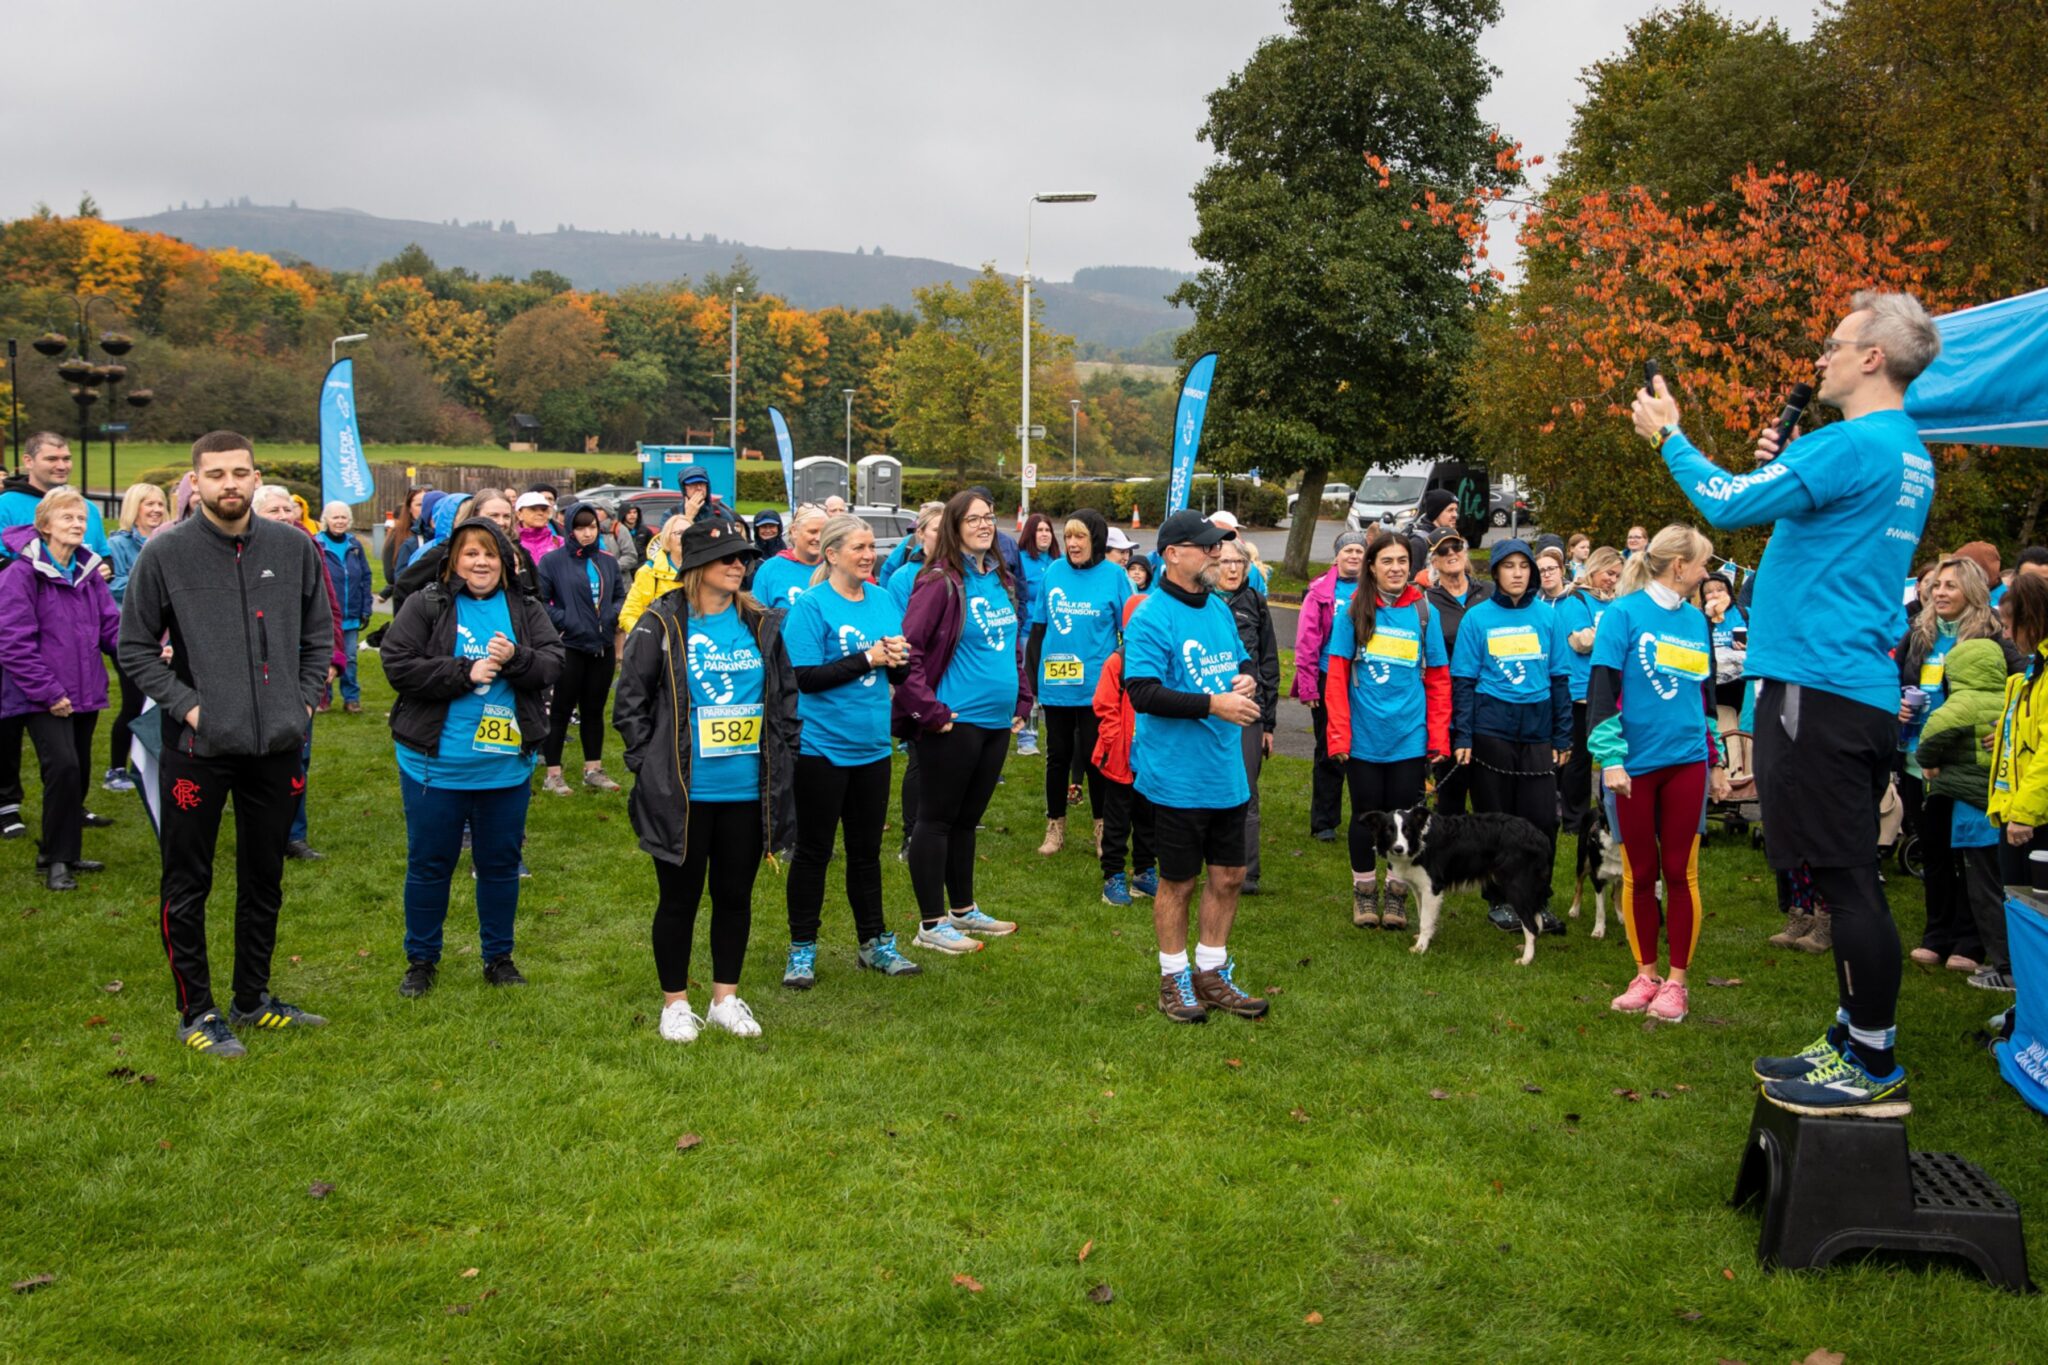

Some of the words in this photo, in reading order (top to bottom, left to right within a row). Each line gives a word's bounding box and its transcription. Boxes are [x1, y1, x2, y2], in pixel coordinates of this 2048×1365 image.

[1057, 600, 1076, 608] WALK
[1056, 607, 1100, 617] PARKINSON'S
[463, 643, 489, 654] WAL
[856, 639, 878, 650] WAL
[733, 649, 753, 660] FOR
[1199, 654, 1219, 666] WALK
[1219, 651, 1233, 661] FOR
[1050, 663, 1078, 677] 545
[703, 706, 756, 717] PARKINSON'S
[478, 719, 514, 742] 581
[711, 720, 754, 743] 582
